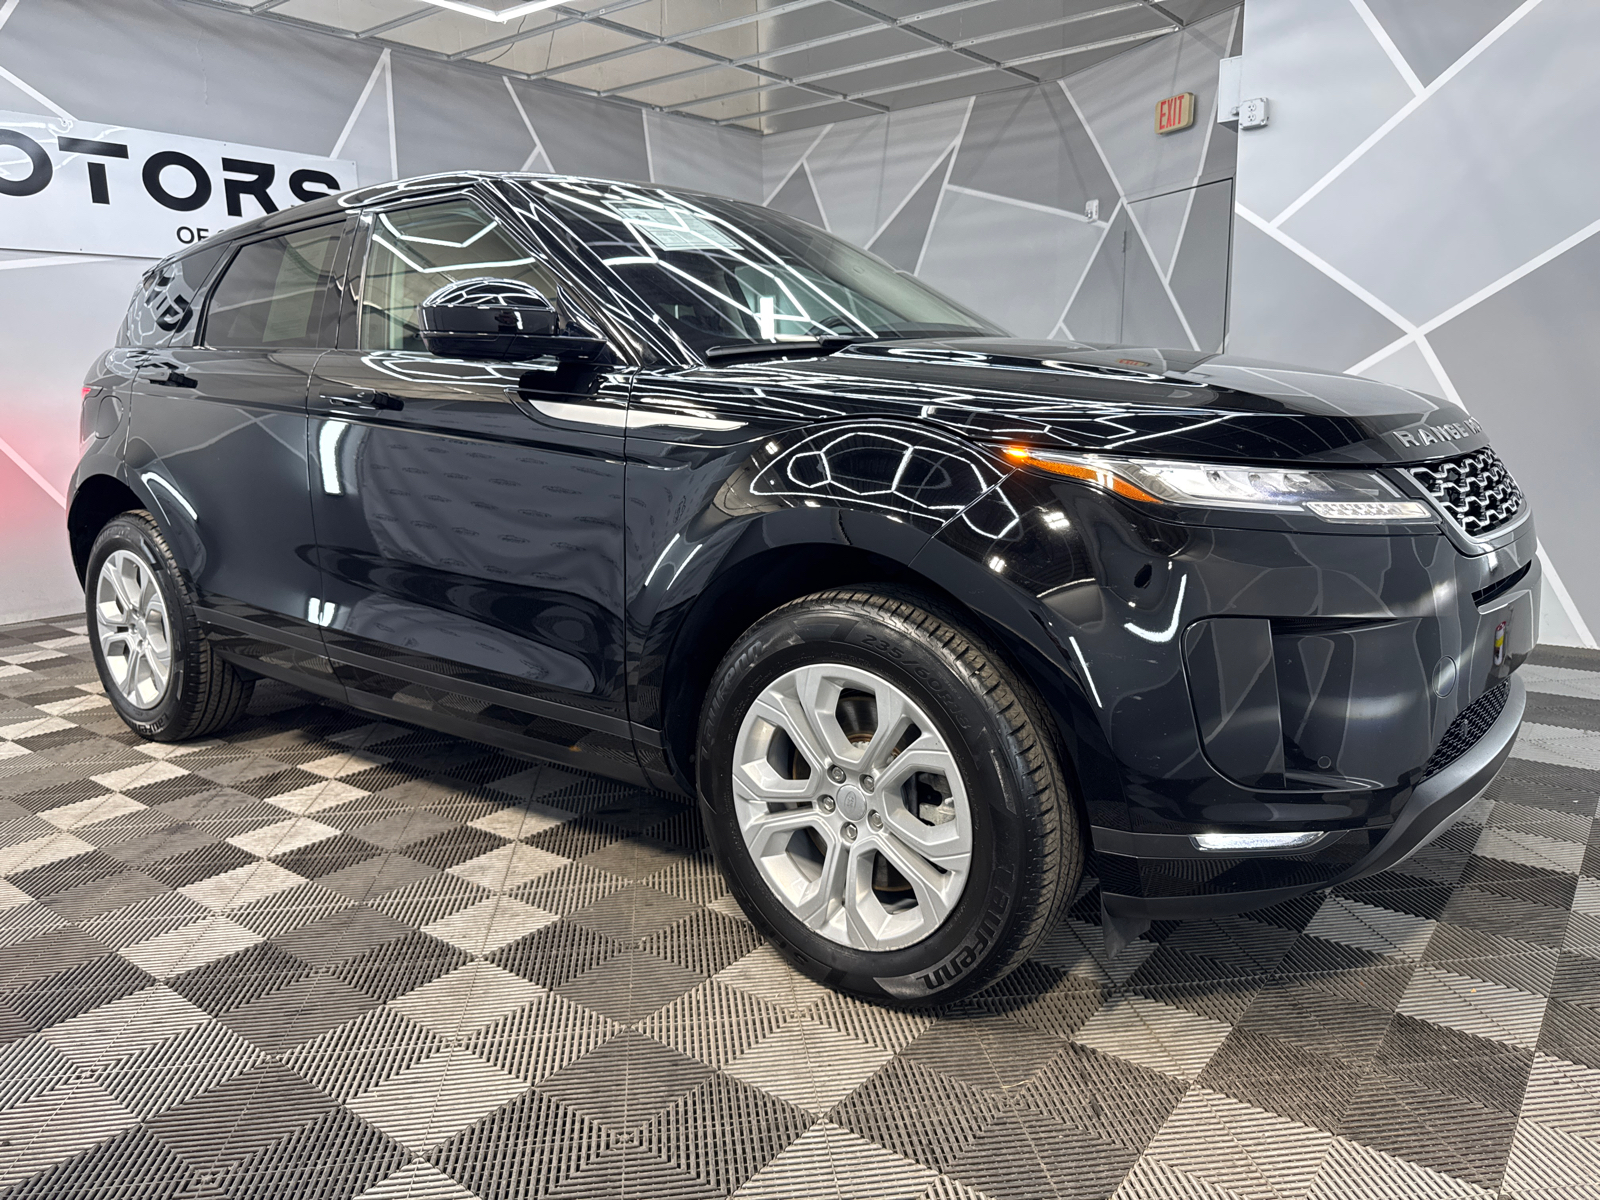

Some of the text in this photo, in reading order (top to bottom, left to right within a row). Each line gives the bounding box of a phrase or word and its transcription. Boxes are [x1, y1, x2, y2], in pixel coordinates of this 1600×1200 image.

[1158, 95, 1185, 130] EXIT
[176, 226, 209, 244] OF
[1393, 422, 1469, 447] RANGE
